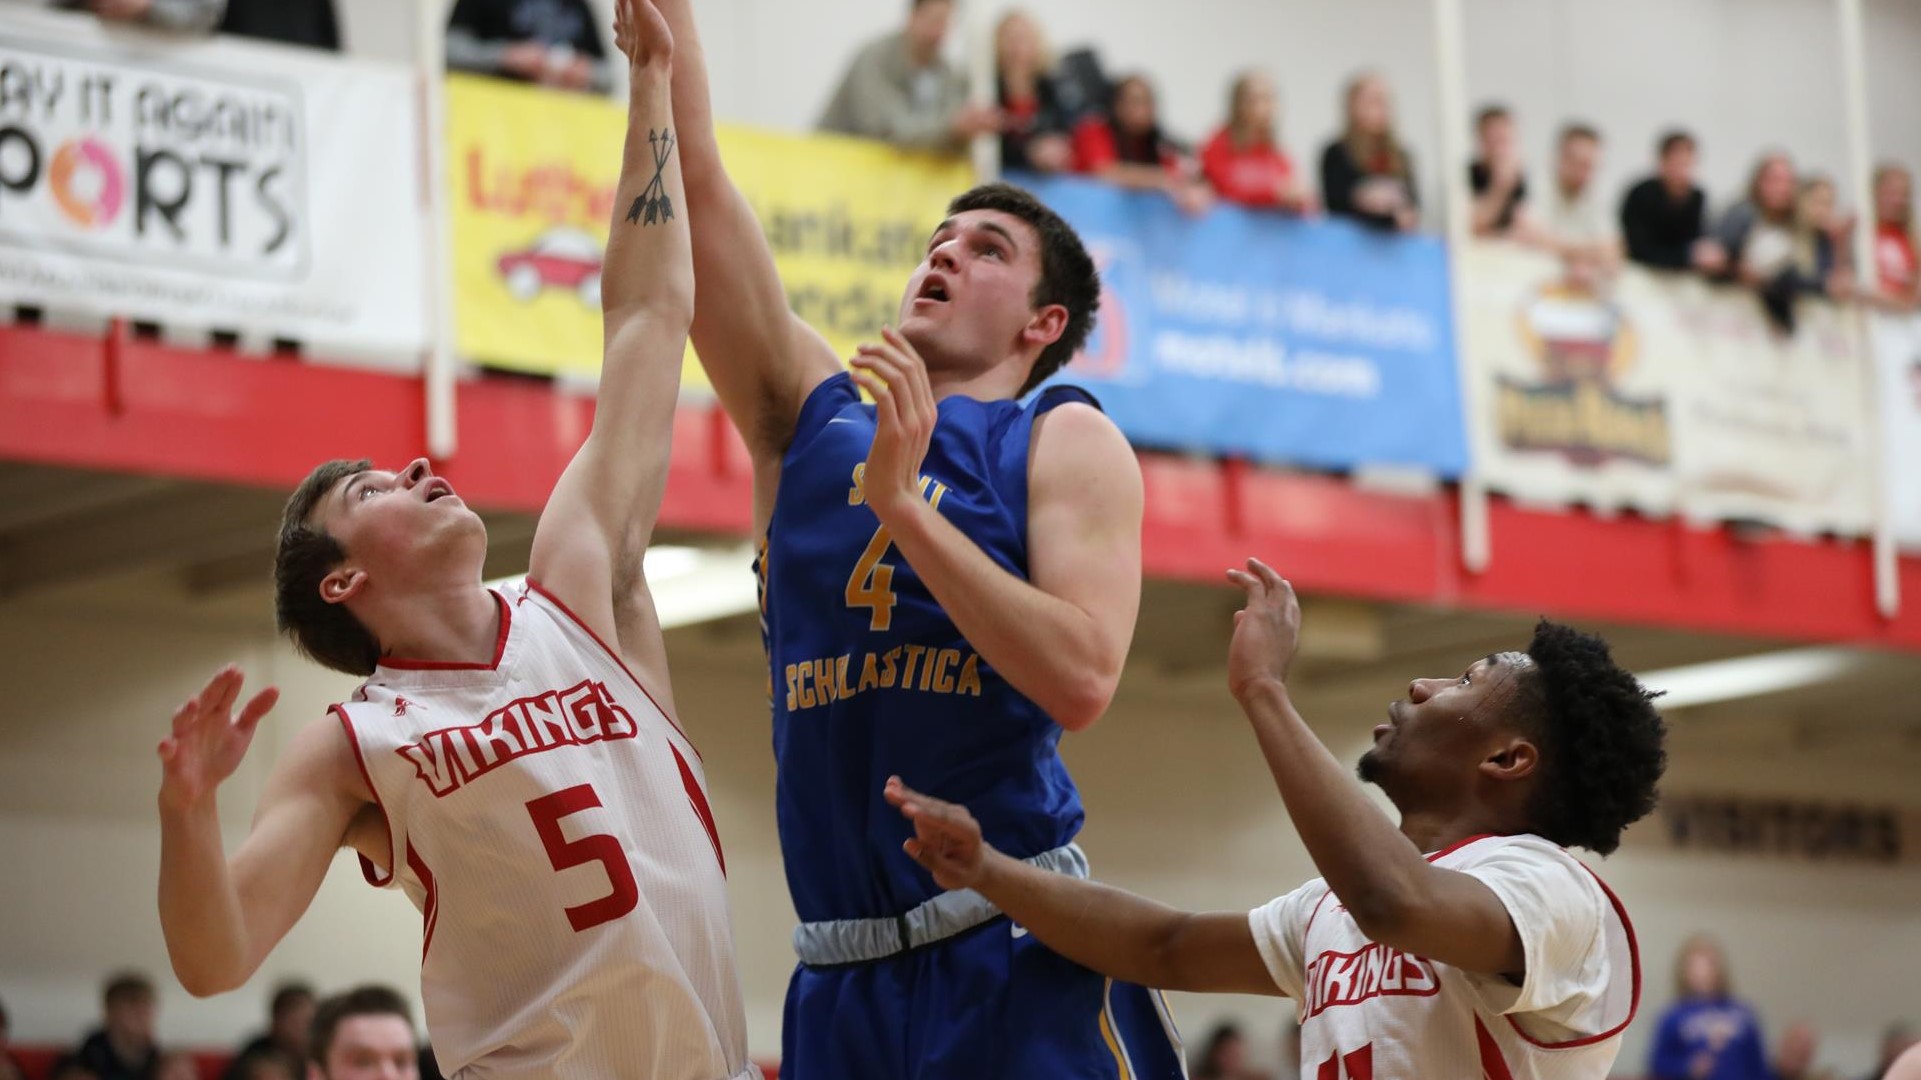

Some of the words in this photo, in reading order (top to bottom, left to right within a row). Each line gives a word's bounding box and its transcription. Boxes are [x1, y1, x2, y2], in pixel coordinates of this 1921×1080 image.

[78, 72, 118, 126] IT
[465, 142, 618, 222] Luthe
[845, 523, 897, 631] 4
[785, 644, 981, 713] SCHLASTICA
[394, 678, 639, 798] VIKINGS
[524, 783, 639, 933] 5
